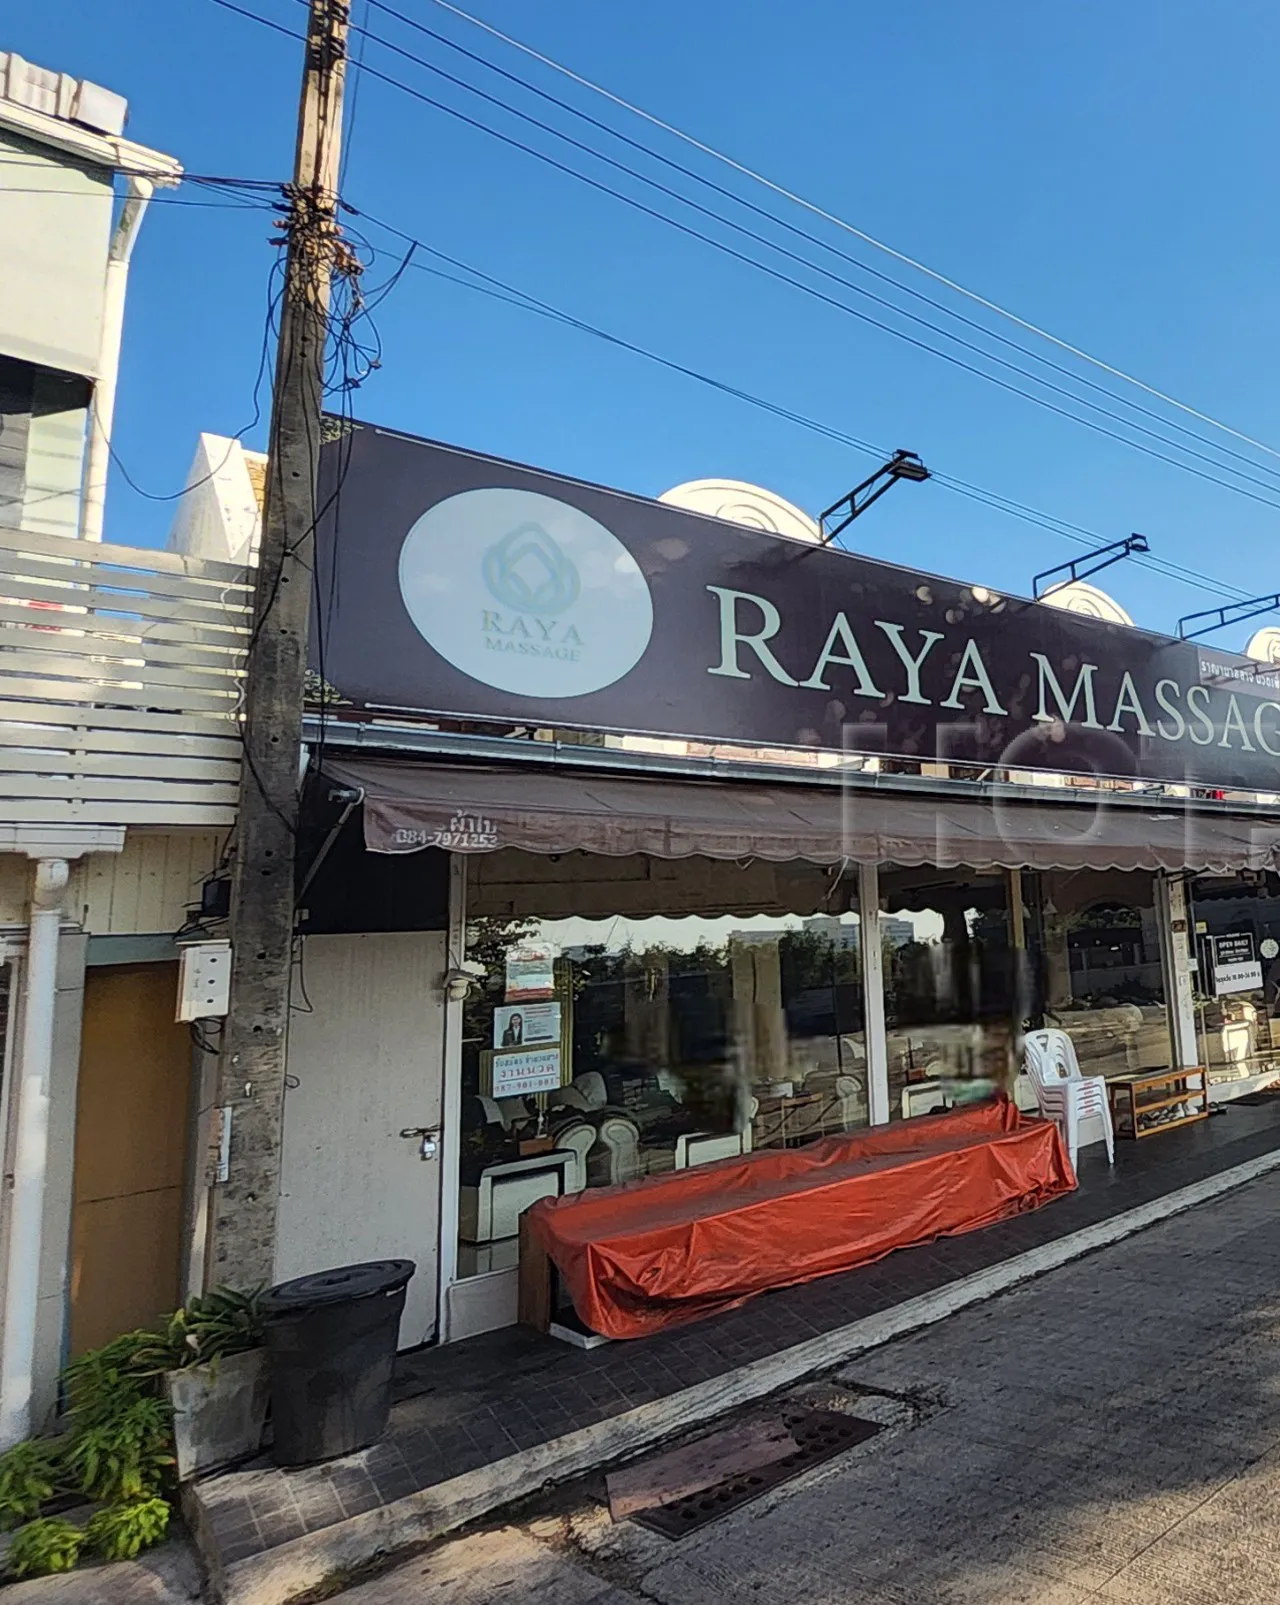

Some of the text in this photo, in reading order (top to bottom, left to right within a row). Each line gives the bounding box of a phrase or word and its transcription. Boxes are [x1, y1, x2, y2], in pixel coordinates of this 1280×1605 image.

[480, 607, 587, 647] RAYA
[483, 636, 583, 662] MASSAGE
[706, 584, 1008, 717] RAYA
